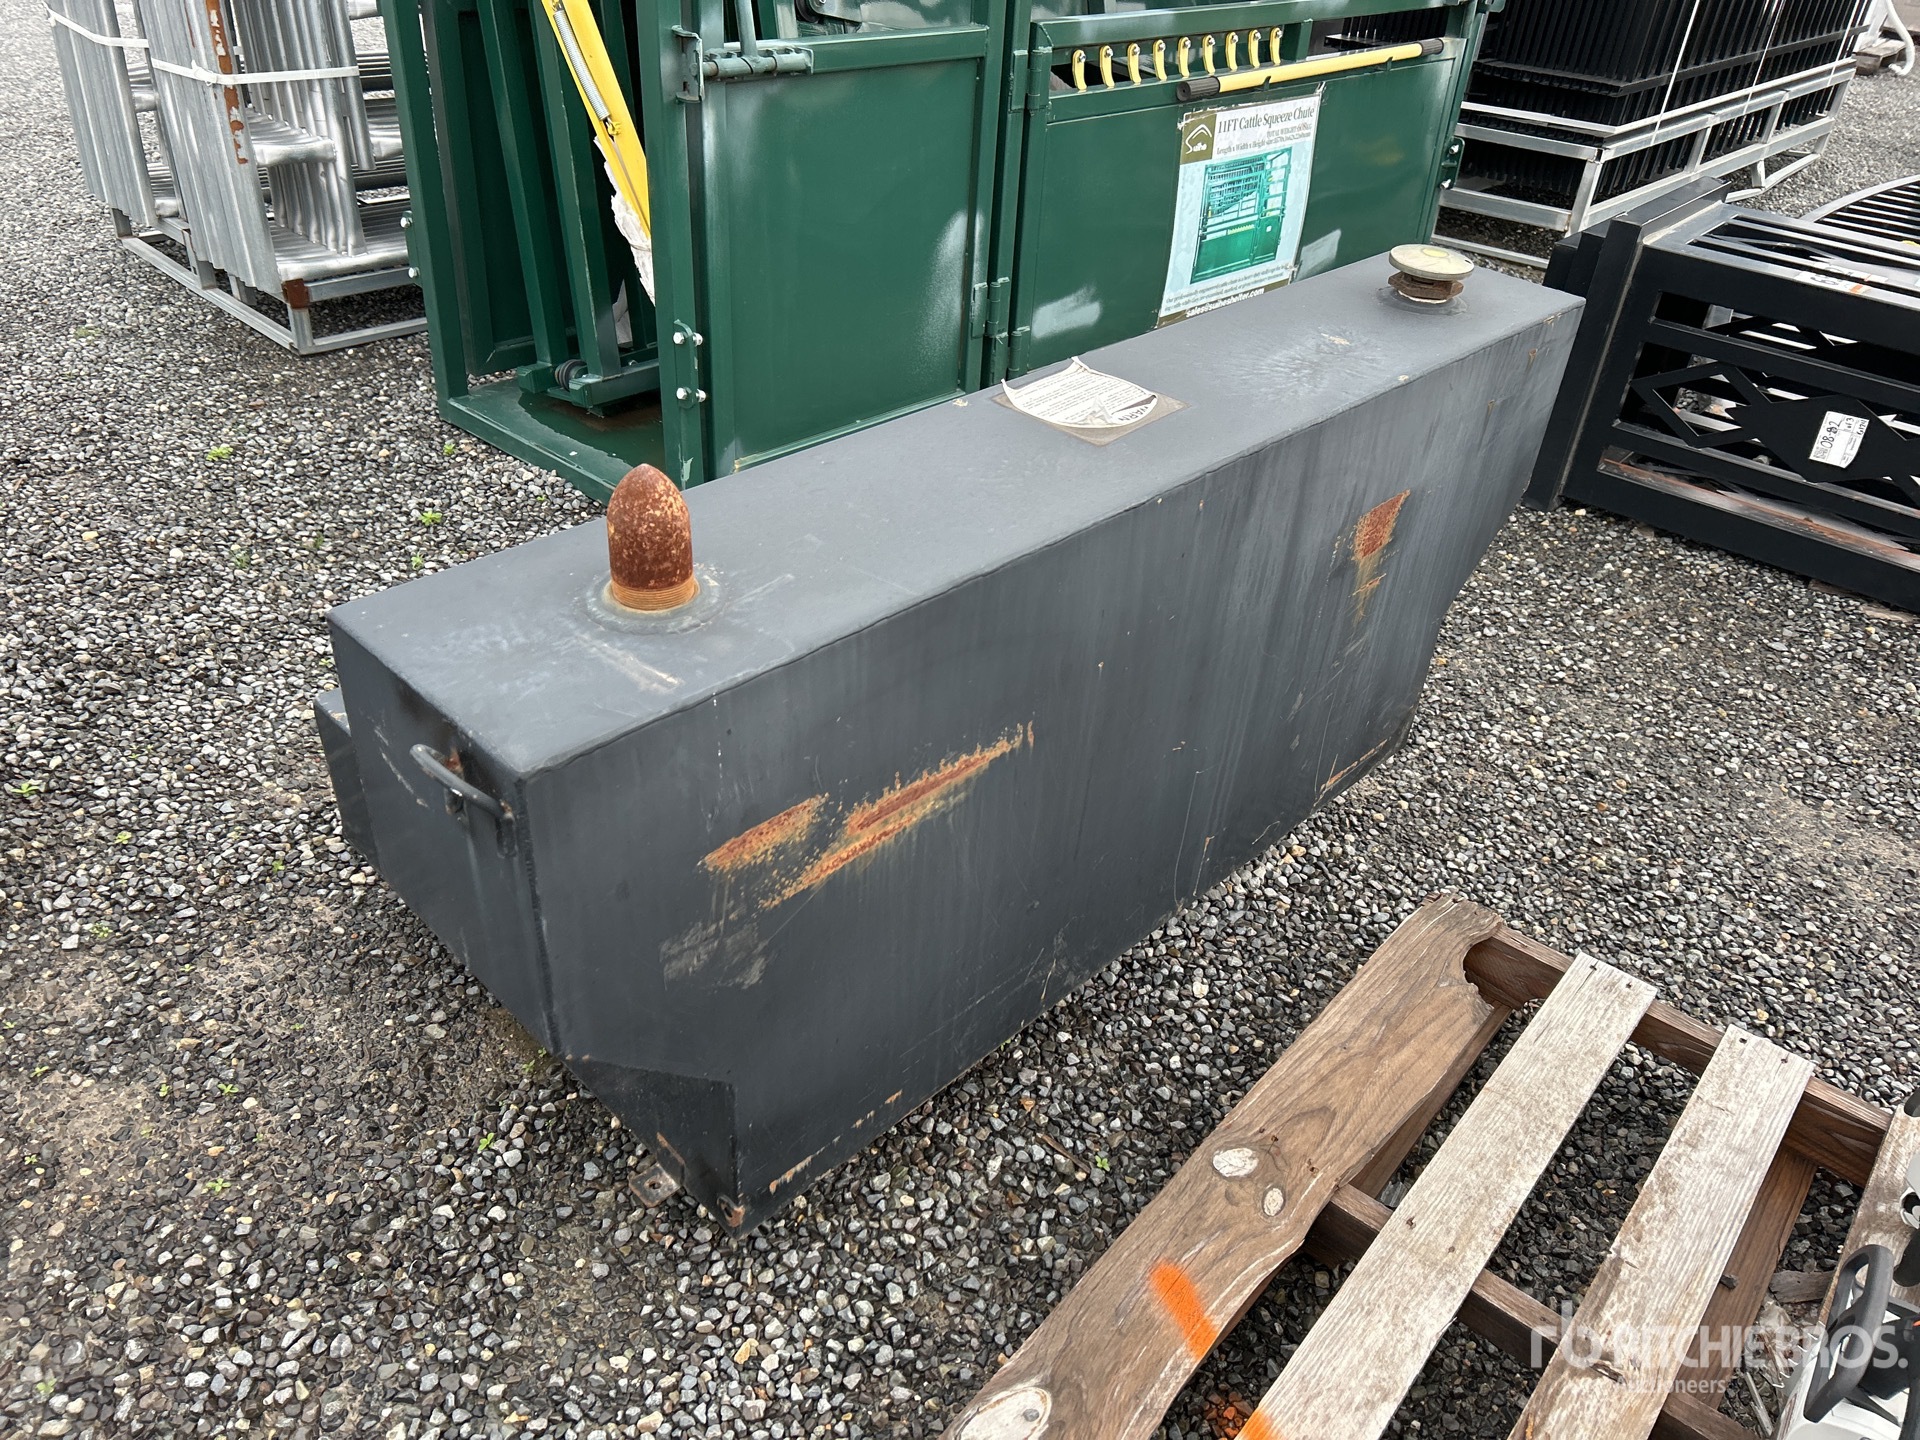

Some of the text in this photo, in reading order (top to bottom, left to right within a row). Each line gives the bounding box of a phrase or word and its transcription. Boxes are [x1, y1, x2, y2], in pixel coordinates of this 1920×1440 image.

[1217, 106, 1316, 134] 11FT Cattle Squeeze Chute
[1216, 145, 1232, 155] Length
[1236, 142, 1249, 151] Width
